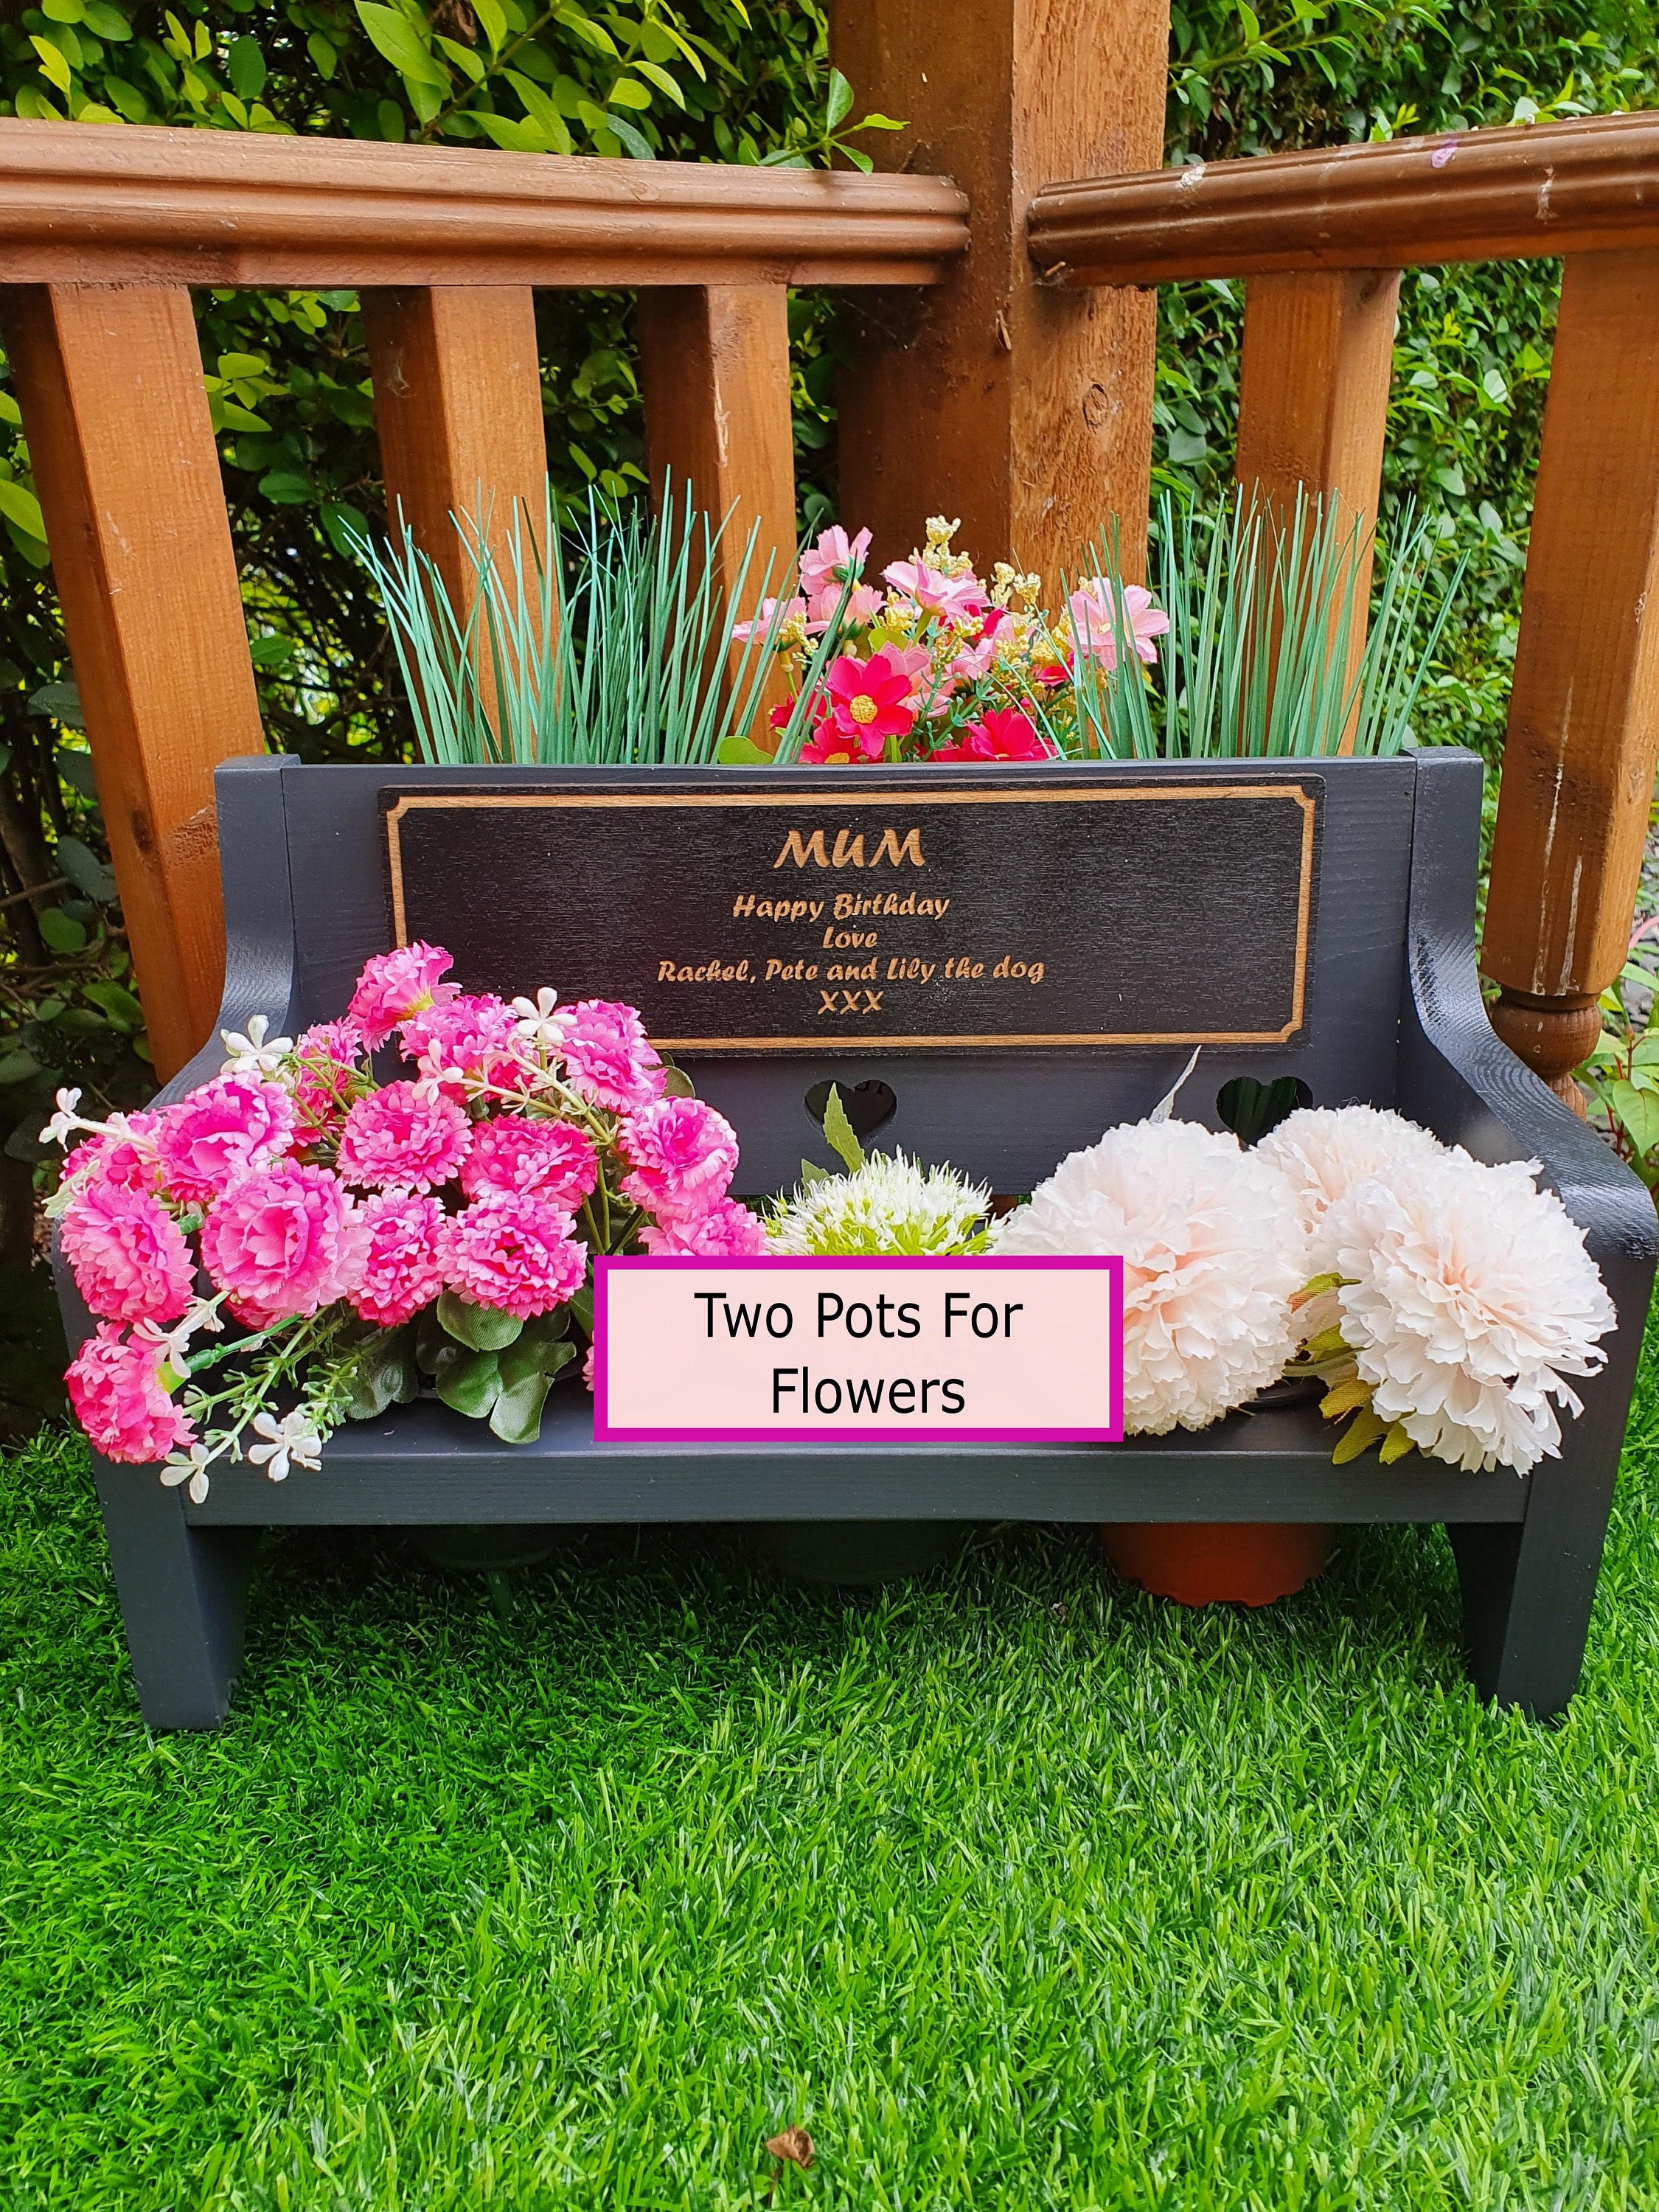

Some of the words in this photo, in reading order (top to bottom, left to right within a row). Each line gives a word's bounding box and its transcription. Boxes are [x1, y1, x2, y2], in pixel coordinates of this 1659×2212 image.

[773, 828, 925, 868] MUM
[732, 894, 824, 921] Happy
[833, 892, 949, 919] Birthday
[823, 926, 877, 948] Love
[657, 959, 756, 983] Rachel,
[765, 959, 818, 980] Pete
[827, 957, 877, 980] and
[887, 957, 935, 983] Lily
[945, 957, 984, 978] the
[992, 956, 1044, 984] dog
